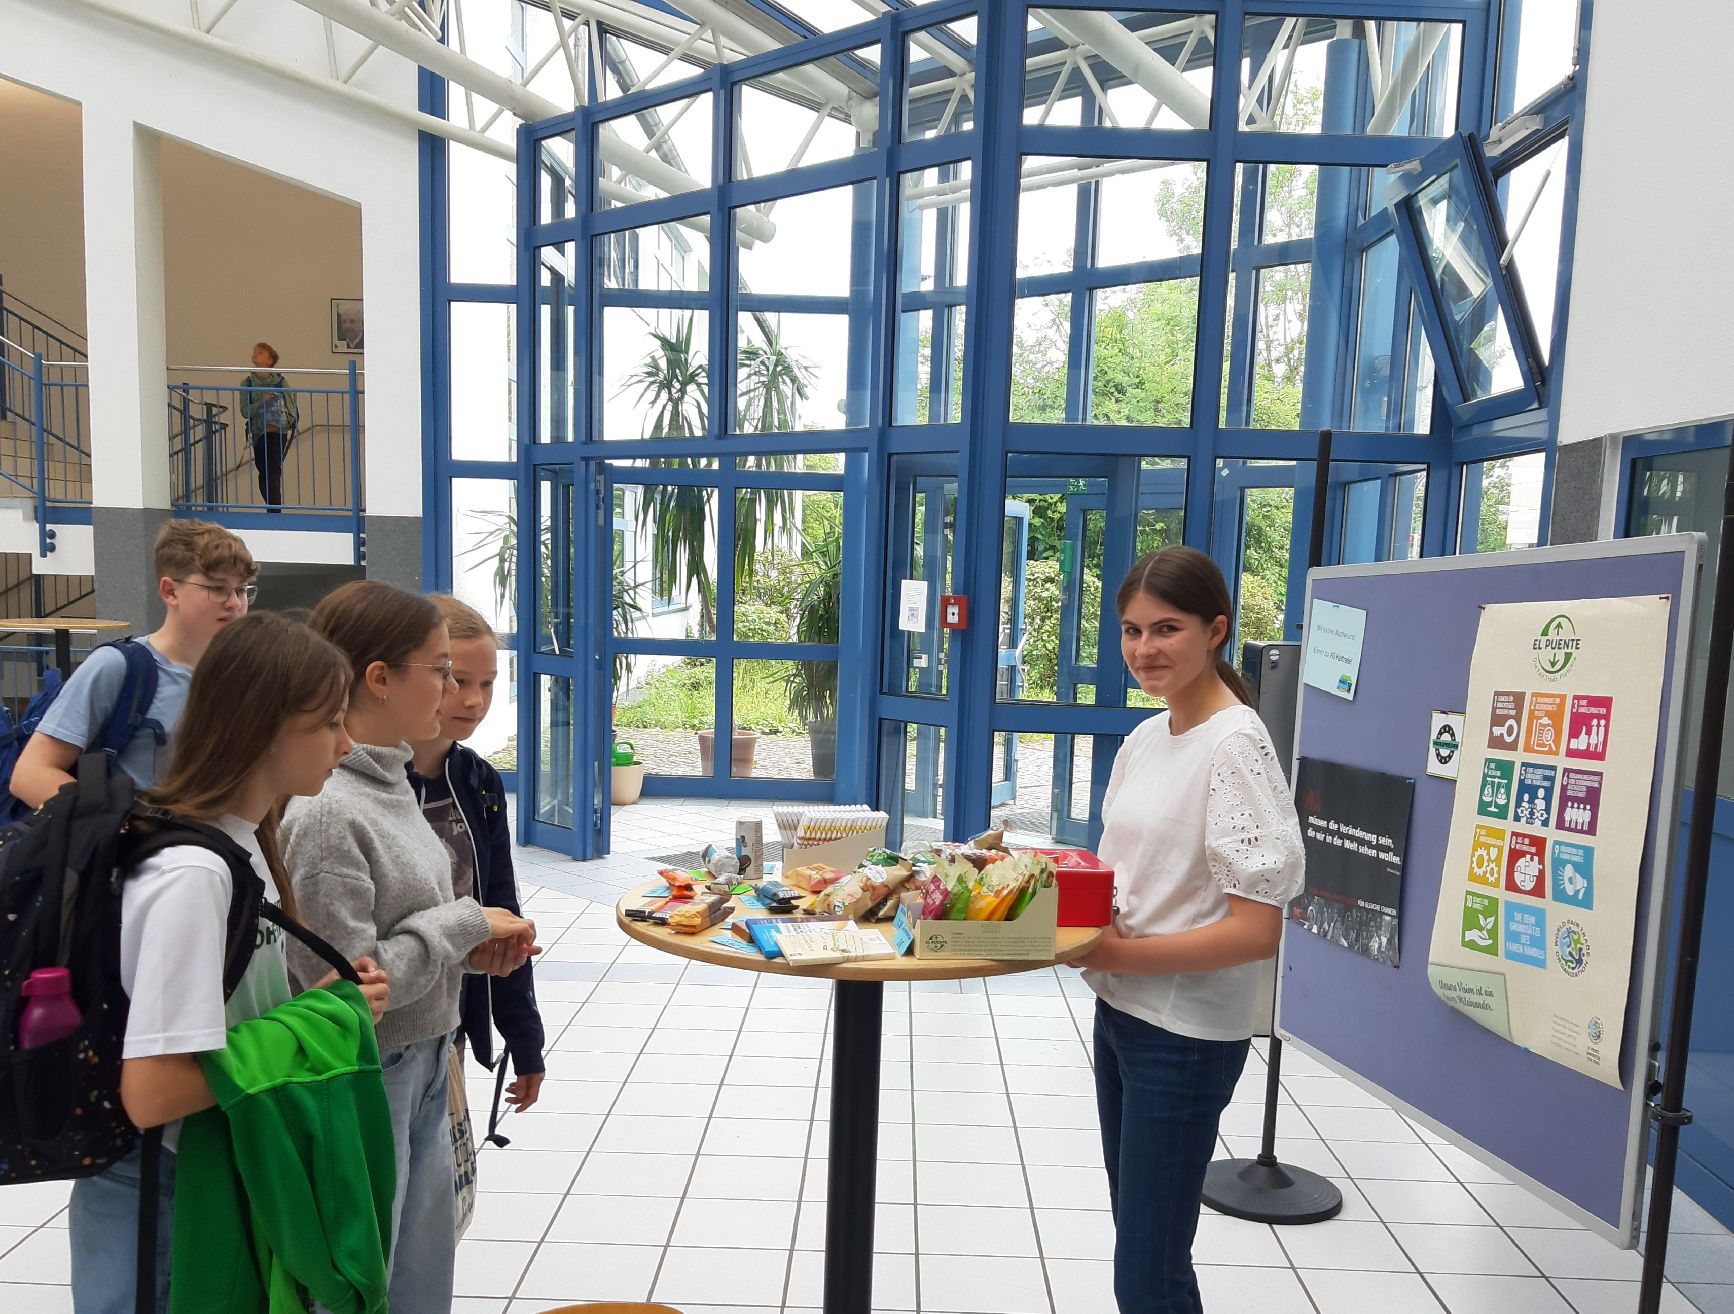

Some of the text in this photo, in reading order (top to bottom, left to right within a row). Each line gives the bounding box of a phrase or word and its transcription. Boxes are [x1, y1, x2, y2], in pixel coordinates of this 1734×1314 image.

[1532, 638, 1581, 650] EL PUENTE
[1531, 696, 1537, 710] 2
[1572, 699, 1578, 712] 3
[1520, 767, 1526, 780] 5
[1562, 772, 1568, 785] 6
[1308, 815, 1394, 849] müssen die Veränderung sein,
[1475, 829, 1480, 841] 7
[1307, 827, 1401, 864] die wir in der Welt sehen wollen.
[1511, 836, 1516, 849] 8
[1554, 845, 1560, 857] 9
[1554, 921, 1567, 947] WORLD
[1567, 920, 1580, 929] FAIR
[1554, 951, 1589, 978] ORGANIZATION
